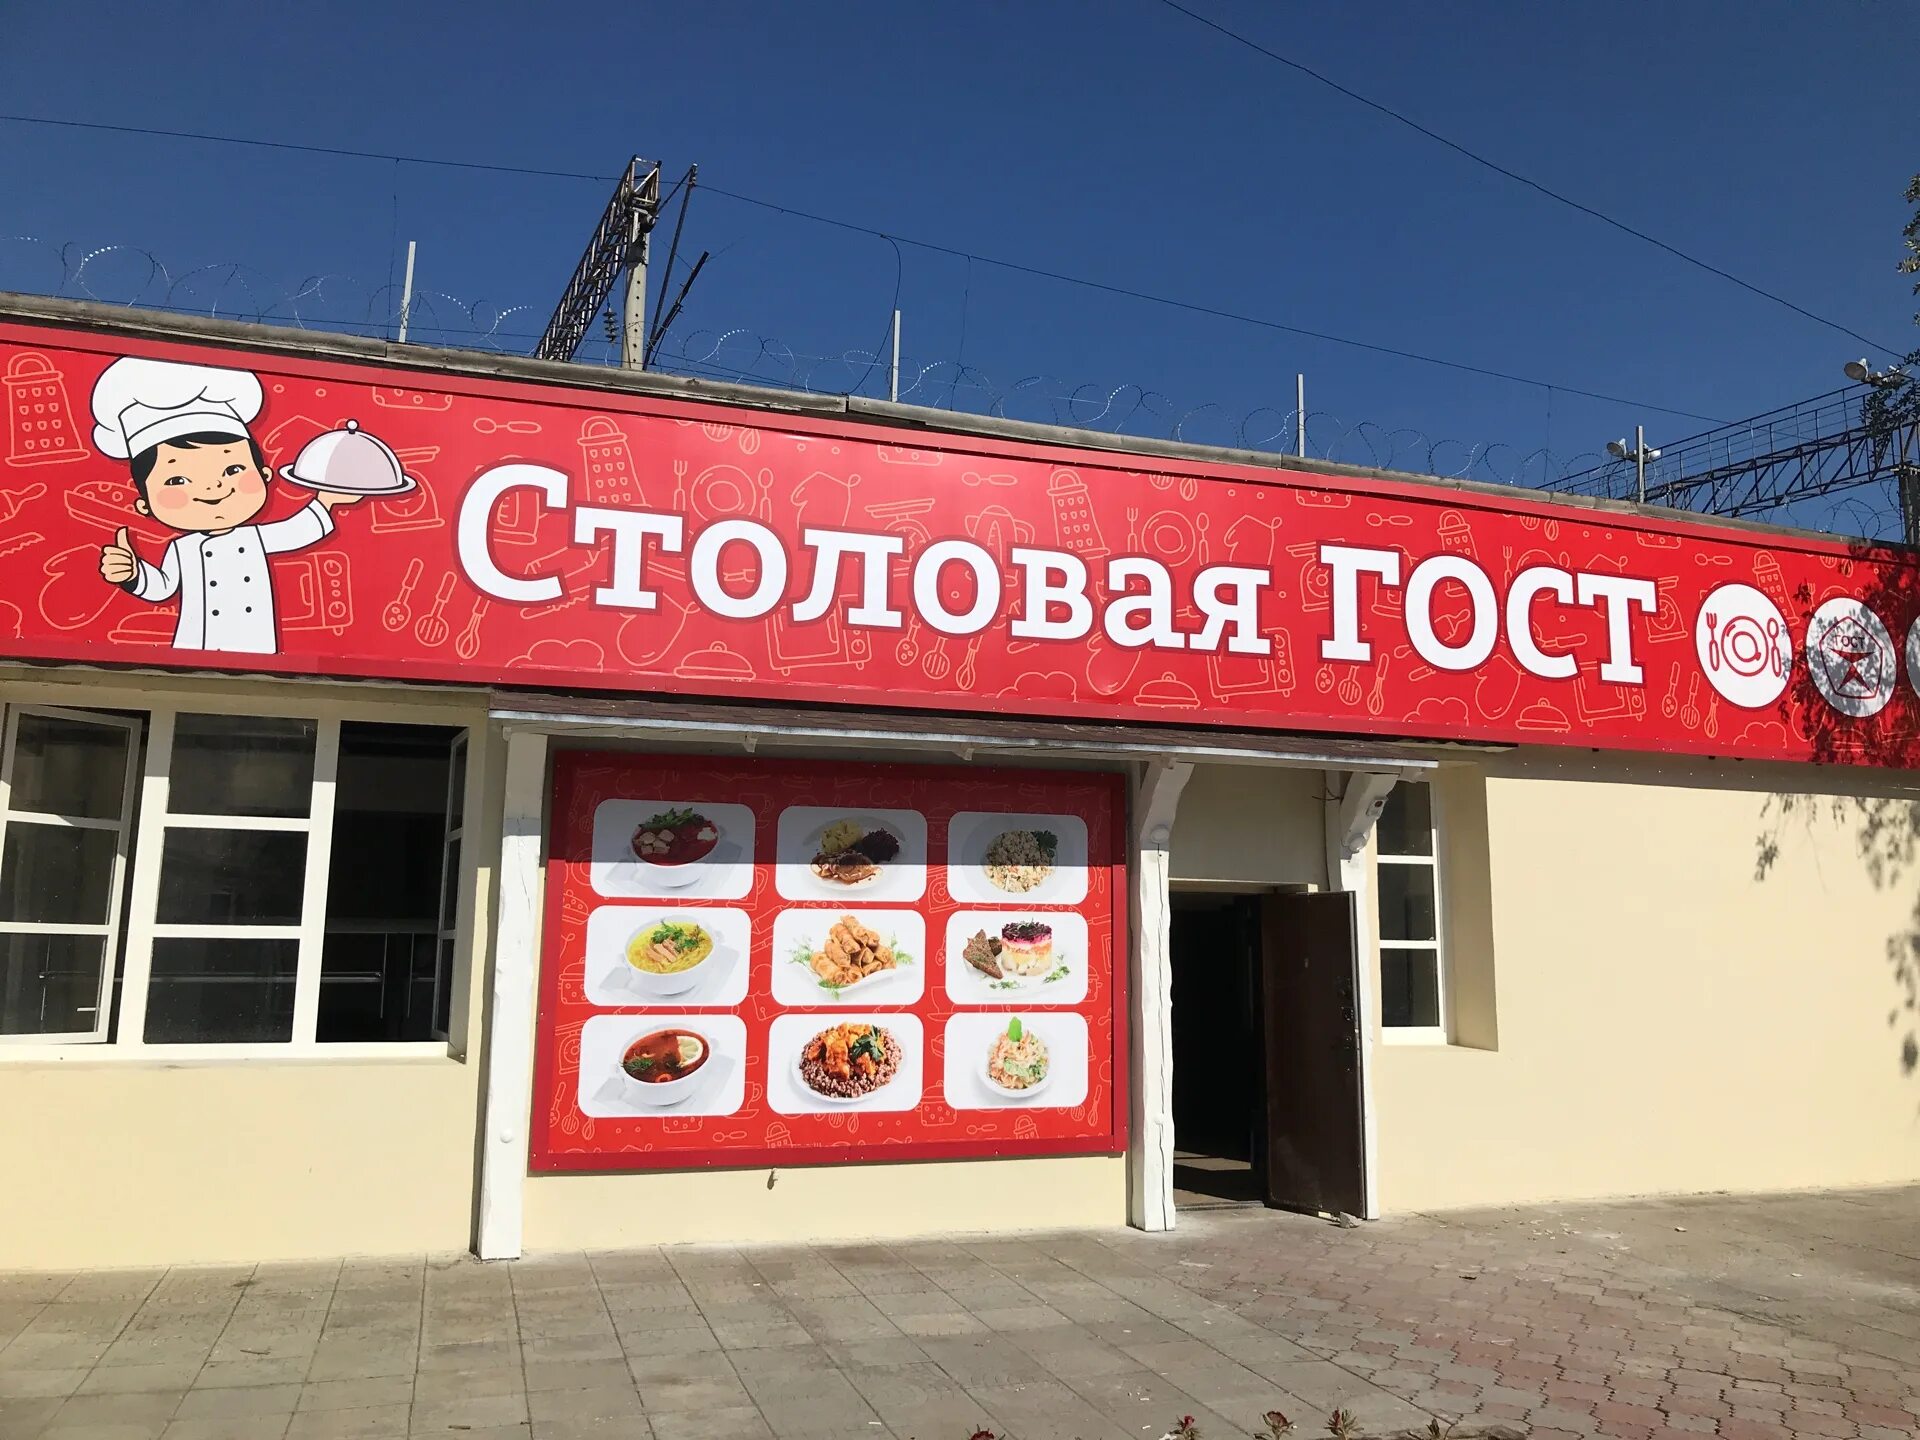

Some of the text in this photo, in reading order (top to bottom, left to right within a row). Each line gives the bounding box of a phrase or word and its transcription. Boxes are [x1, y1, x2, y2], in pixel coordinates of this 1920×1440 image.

[457, 463, 1657, 684] Столовая ГОСТ
[1833, 634, 1866, 649] ГОСТ
